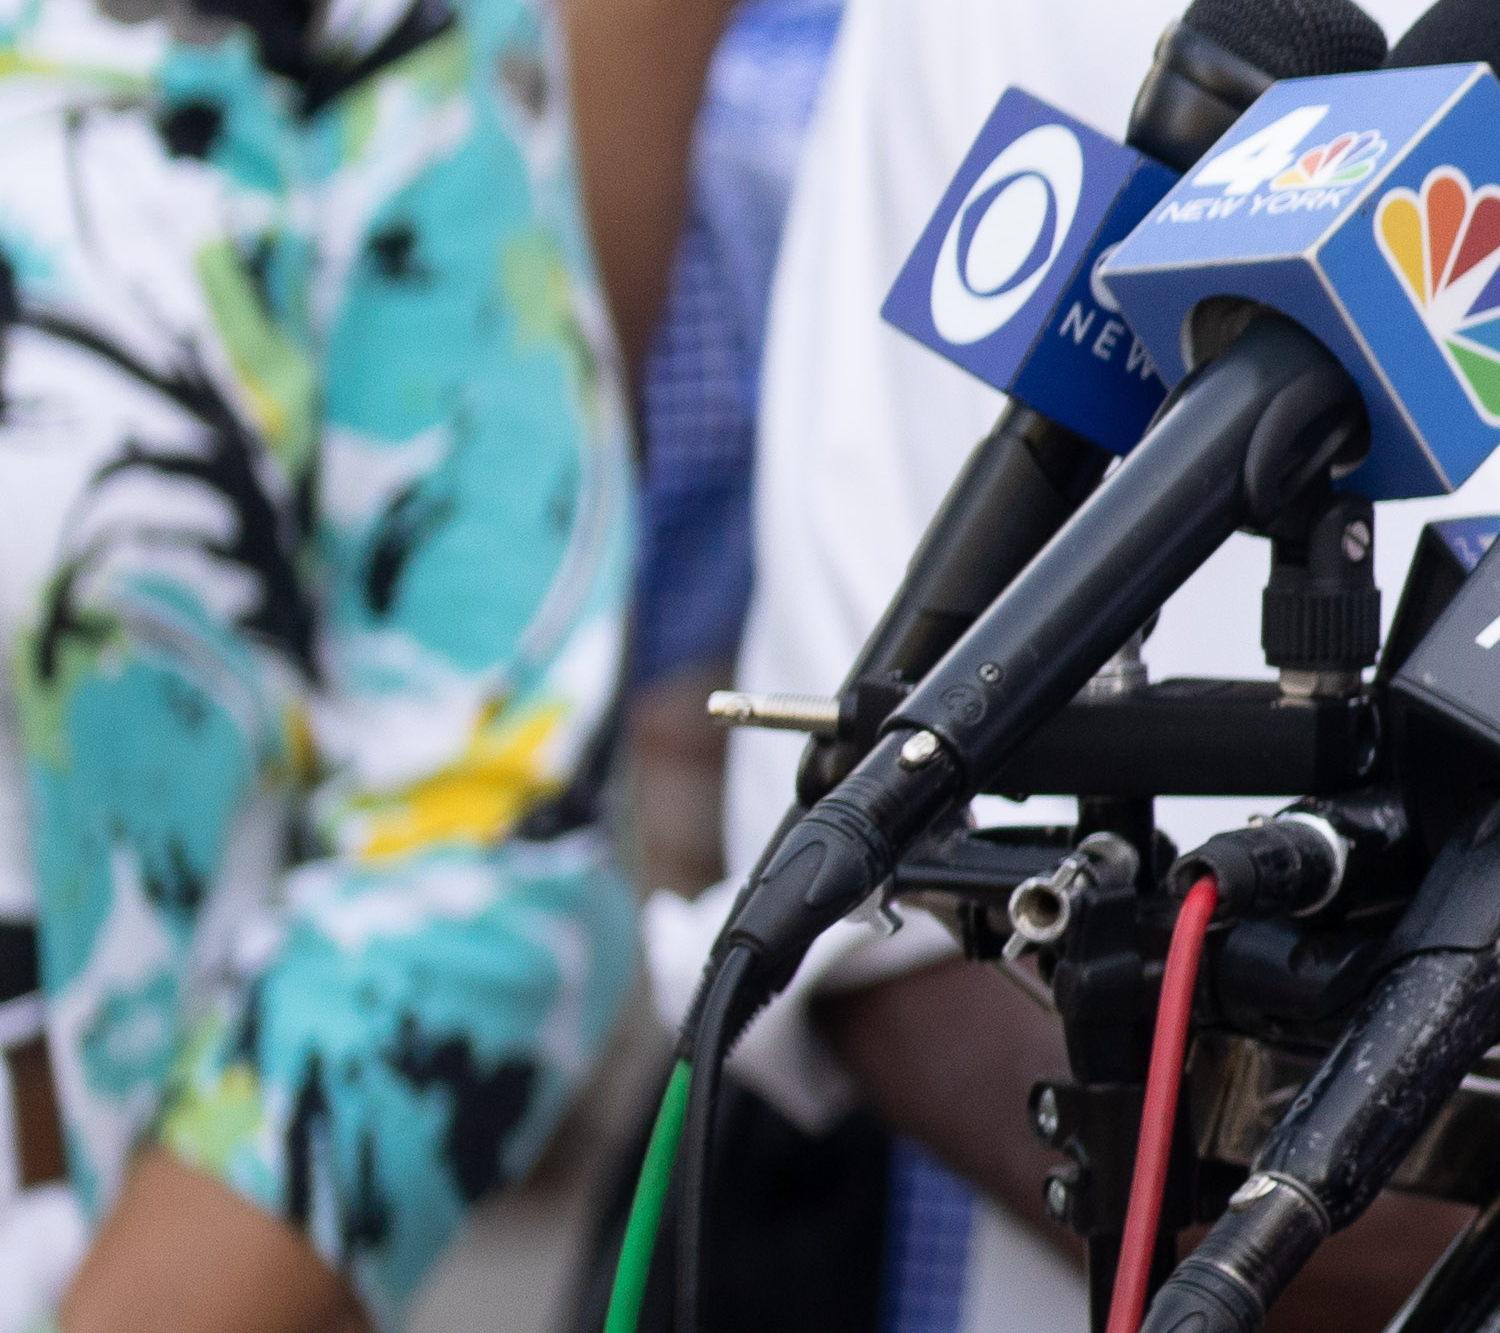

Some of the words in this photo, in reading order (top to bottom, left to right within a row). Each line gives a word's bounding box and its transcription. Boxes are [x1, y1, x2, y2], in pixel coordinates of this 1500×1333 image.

[1192, 105, 1330, 196] 4
[1157, 194, 1244, 225] NEW
[1250, 188, 1352, 216] YORK
